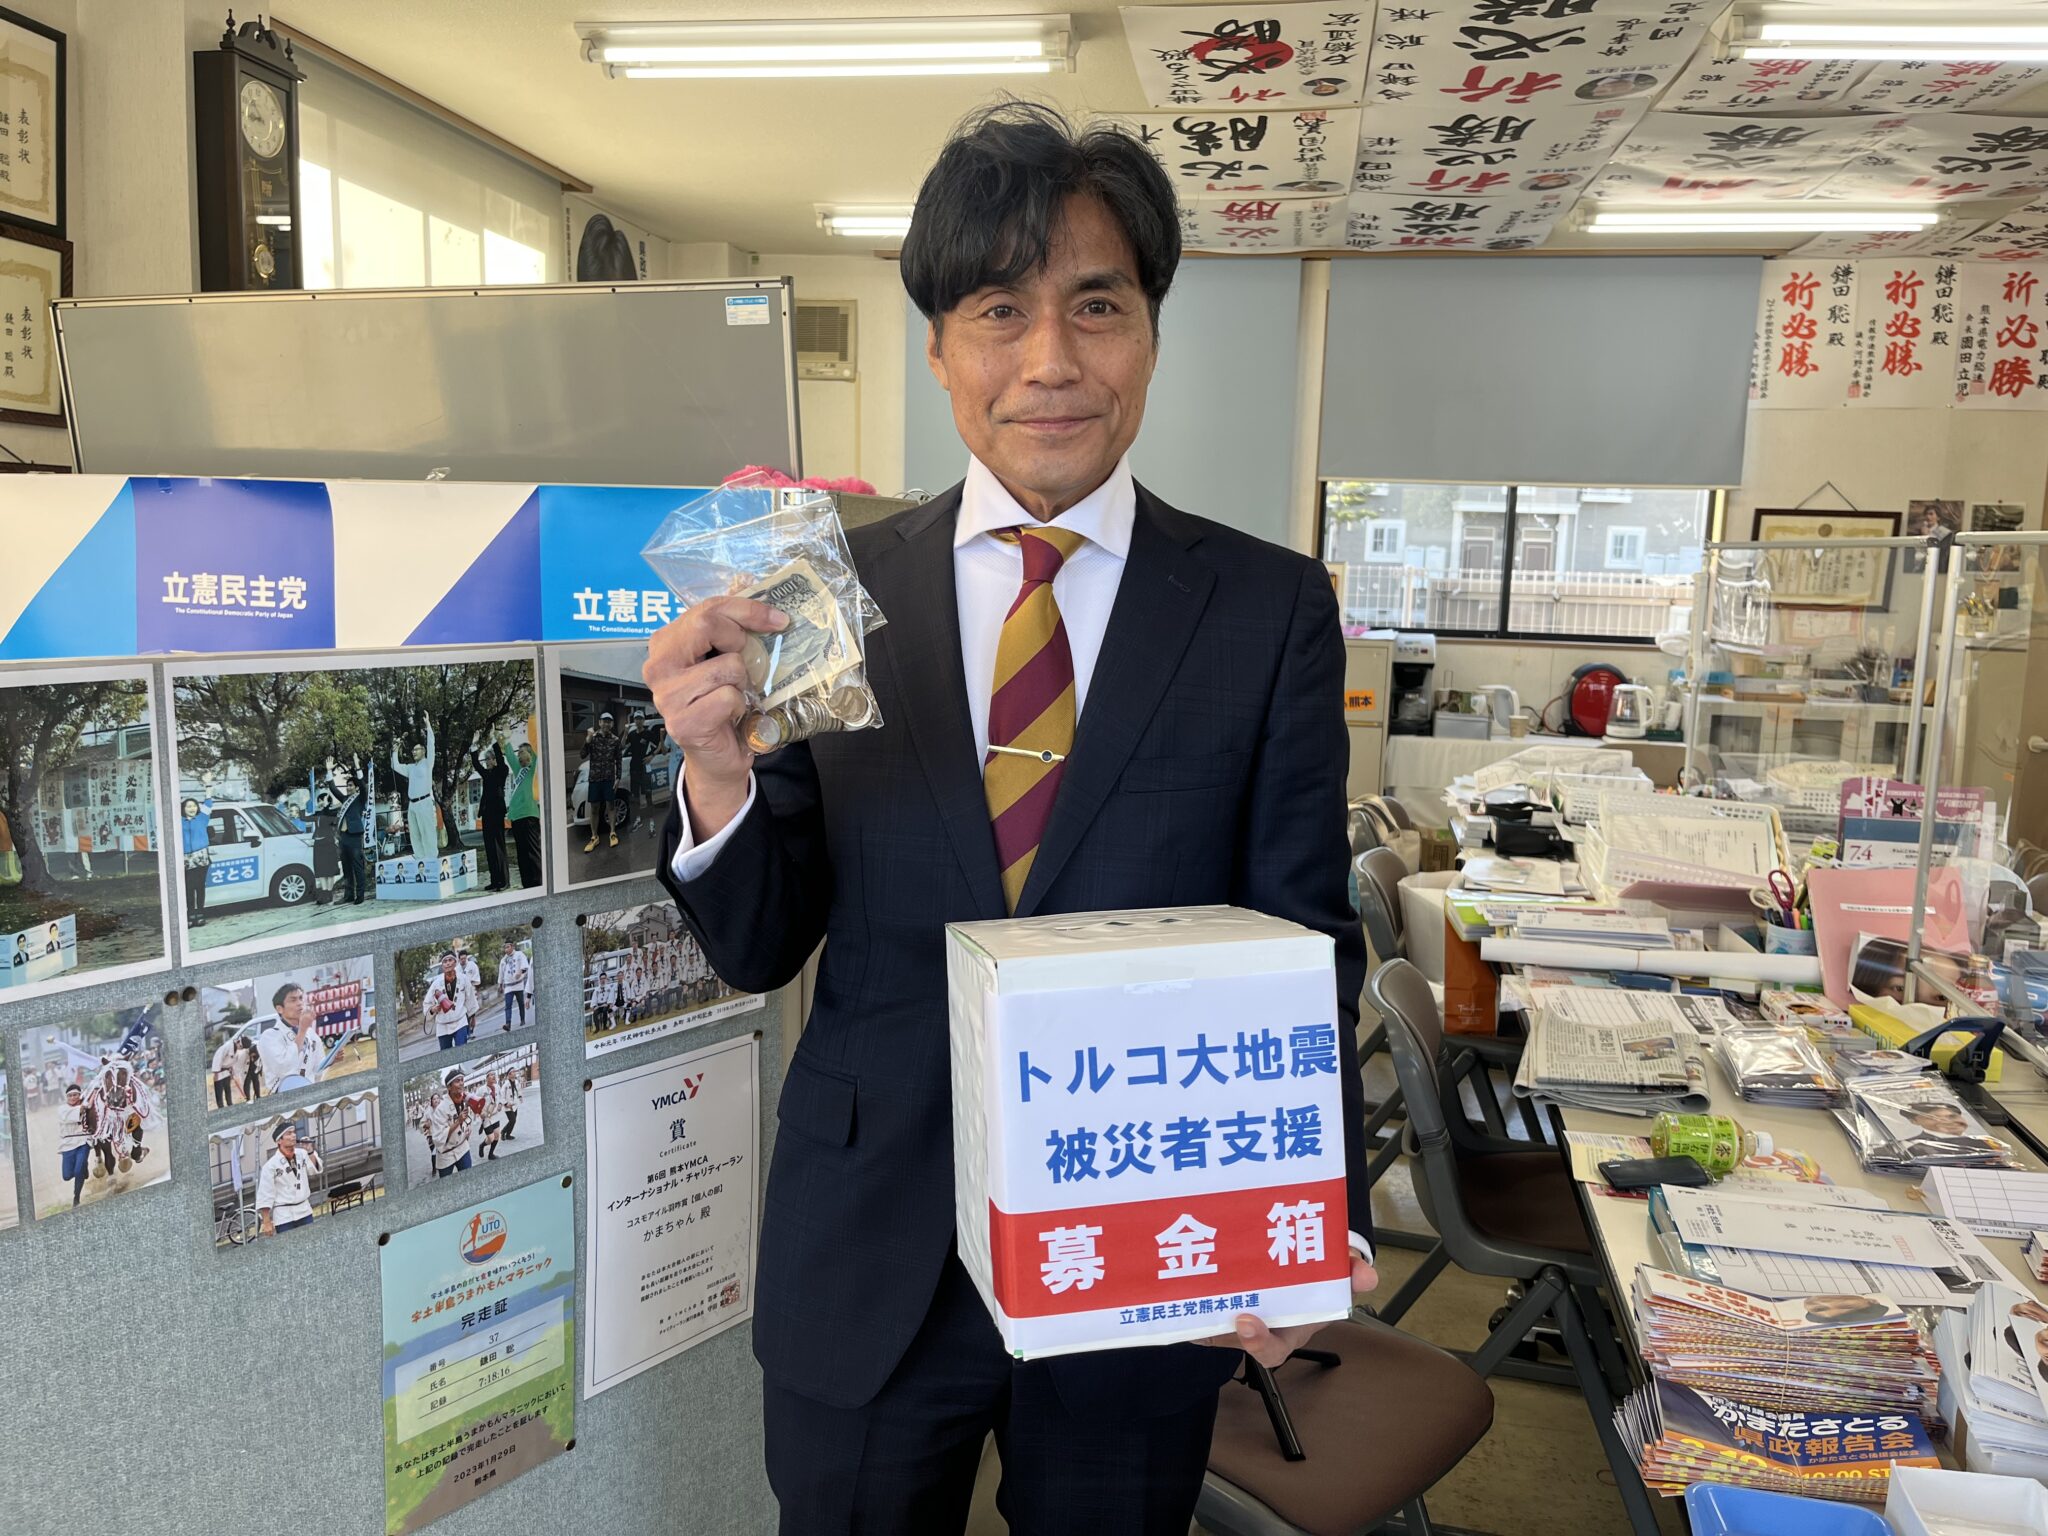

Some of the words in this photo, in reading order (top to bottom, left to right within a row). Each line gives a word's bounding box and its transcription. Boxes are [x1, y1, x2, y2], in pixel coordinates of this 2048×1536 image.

[1322, 13, 1363, 66] 石橋通宏
[1150, 48, 1206, 104] 鎌田さとる殿
[1180, 19, 1287, 104] 祈必勝
[17, 108, 32, 165] 表彰状
[1409, 114, 1537, 192] 祈必勝
[1389, 200, 1491, 248] 祈必勝
[1777, 272, 1822, 379] 祈必勝
[1826, 264, 1854, 347] 鎌田聡殿
[1881, 270, 1926, 378] 祈必勝
[1930, 264, 1957, 347] 鎌田聡殿
[20, 306, 34, 360] 表彰状
[1988, 271, 2040, 399] 祈必勝
[161, 570, 308, 611] 立憲民主党
[771, 578, 798, 602] 1000
[174, 606, 186, 615] The
[186, 607, 224, 616] Constitutional
[224, 608, 255, 618] Democratic
[255, 610, 270, 619] Party
[270, 611, 278, 619] of
[277, 611, 294, 620] Japan
[588, 625, 601, 633] The
[601, 625, 644, 634] Constitutional
[1348, 695, 1373, 708] 熊本
[1943, 799, 1980, 810] FINISHER
[211, 864, 255, 884] さとる
[1017, 1022, 1339, 1103] トルコ大地震
[651, 1089, 687, 1111] YMCA
[659, 1139, 697, 1158] Certificate
[669, 1118, 687, 1144] 賞
[1045, 1103, 1324, 1184] 被災者支援
[1672, 1143, 1710, 1154] 伊右衛門
[1714, 1143, 1733, 1158] 茶
[607, 1154, 744, 1212] インターナショナル・チャリティーラン
[647, 1169, 667, 1185] 第6回
[669, 1155, 709, 1177] 熊本YMCA
[481, 1219, 501, 1234] UTO
[643, 1211, 697, 1243] かまちゃん
[700, 1204, 712, 1220] 殿
[1038, 1199, 1327, 1296] 募金箱
[410, 1256, 553, 1325] 宇土半島うまかもんマラニック
[1119, 1292, 1261, 1325] 立憲民主党熊本県連
[460, 1297, 510, 1331] 完走証
[429, 1356, 447, 1373] 番号
[488, 1332, 500, 1346] 37
[429, 1376, 448, 1392] 氏名
[479, 1350, 498, 1368] 鎌田
[429, 1395, 448, 1411] 記録
[478, 1365, 511, 1389] 7:18:16
[394, 1382, 568, 1475] あなたは宇土半島うまかもんマラニックにおいて
[1713, 1404, 1909, 1438] かまたさとる
[415, 1406, 550, 1480] 上記の記録で完走したことを証します
[1732, 1431, 1915, 1458] 県政報告会
[453, 1444, 517, 1484] 2023年1月29日
